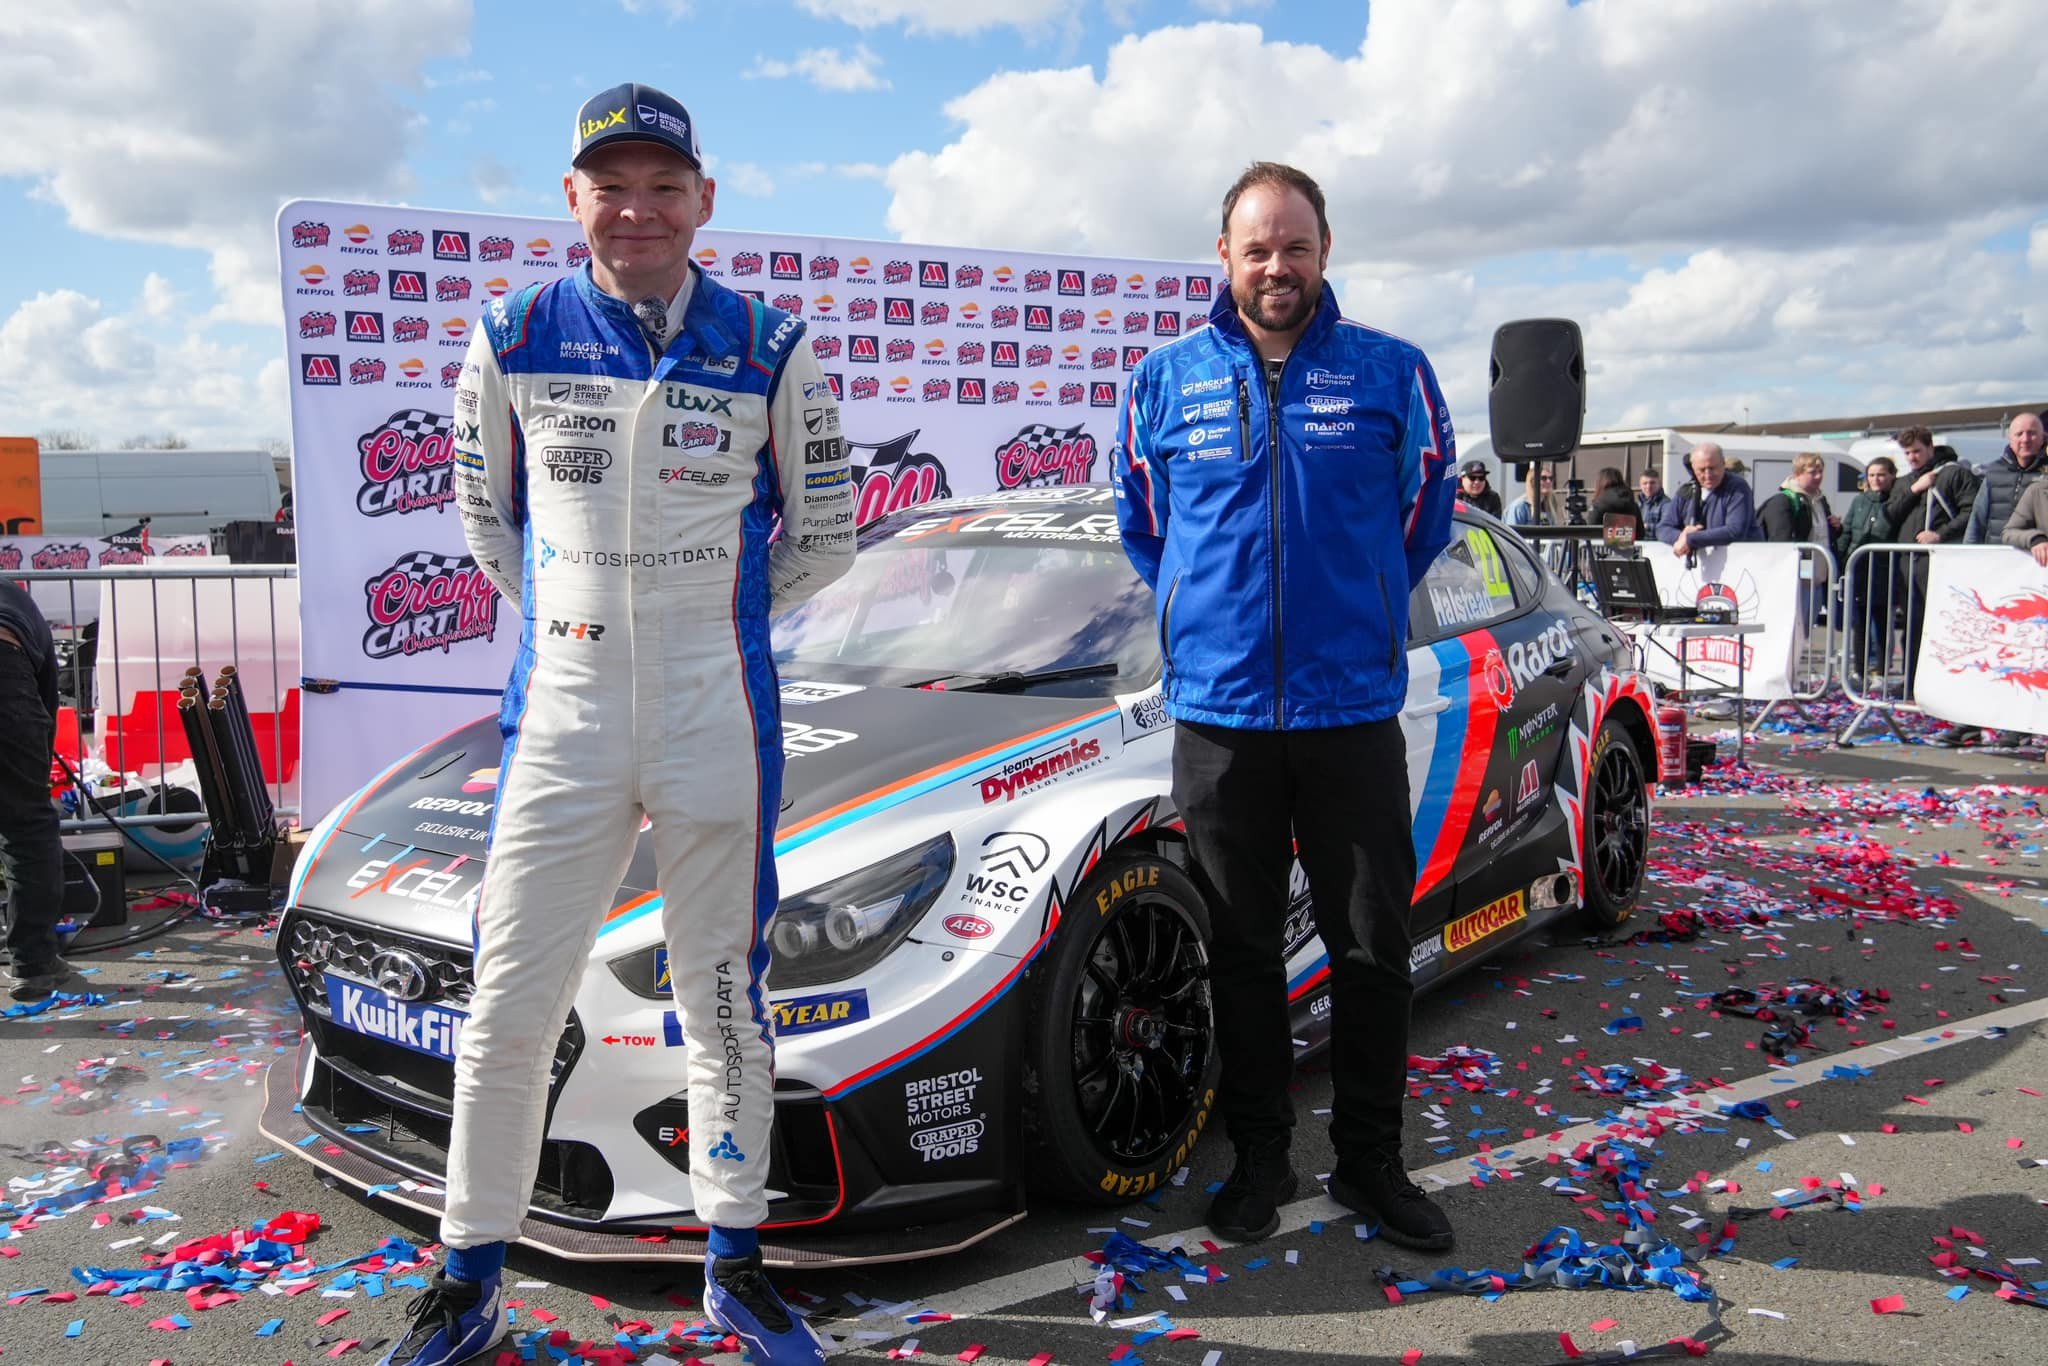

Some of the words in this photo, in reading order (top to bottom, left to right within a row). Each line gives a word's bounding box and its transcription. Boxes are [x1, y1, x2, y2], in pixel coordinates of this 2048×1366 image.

[658, 112, 688, 130] BRISTOL
[660, 118, 686, 134] STREET
[341, 246, 379, 256] REPSOL
[523, 259, 558, 268] REPSOL
[297, 288, 335, 296] REPSOL
[439, 340, 470, 348] REPSO
[560, 341, 620, 356] MACKLIN
[560, 350, 602, 361] MOTORS
[396, 381, 432, 389] REPSOL
[1194, 375, 1233, 388] MACKLIN
[1319, 373, 1355, 381] Hansford
[1319, 378, 1351, 386] Sensors
[574, 391, 609, 401] STREET
[575, 384, 613, 393] BRISTOL
[573, 399, 605, 407] MOTORS
[666, 386, 732, 417] itvX
[1203, 398, 1233, 410] BRISTOL
[1203, 405, 1231, 415] STREET
[1310, 397, 1350, 406] DRAPER
[546, 450, 604, 466] DRAPER
[359, 469, 450, 514] CART
[1429, 582, 1494, 627] Halstead
[364, 611, 455, 655] CART
[1508, 619, 1573, 691] Razor
[1519, 702, 1558, 741] MONSTER
[980, 737, 1101, 804] Dynamics
[1001, 756, 1035, 776] team
[1021, 777, 1059, 796] ALLOY
[1065, 755, 1111, 777] WHEELS
[408, 796, 496, 816] REPSOL
[415, 821, 470, 839] EXCLUSIVE
[469, 831, 488, 842] UK
[966, 873, 1029, 902] WSC
[1095, 865, 1160, 917] EAGLE
[961, 894, 1021, 914] FINANCE
[950, 919, 988, 934] ABS
[1450, 895, 1521, 949] AUTOCAR
[1411, 933, 1443, 964] SCORPION
[622, 1036, 656, 1046] TOW
[716, 960, 743, 1122] AUTOSPORTDATA
[905, 1067, 983, 1098] BRISTOL
[907, 1084, 977, 1112] STREET
[908, 1103, 972, 1127] MOTORS
[917, 1123, 978, 1147] DRAPER
